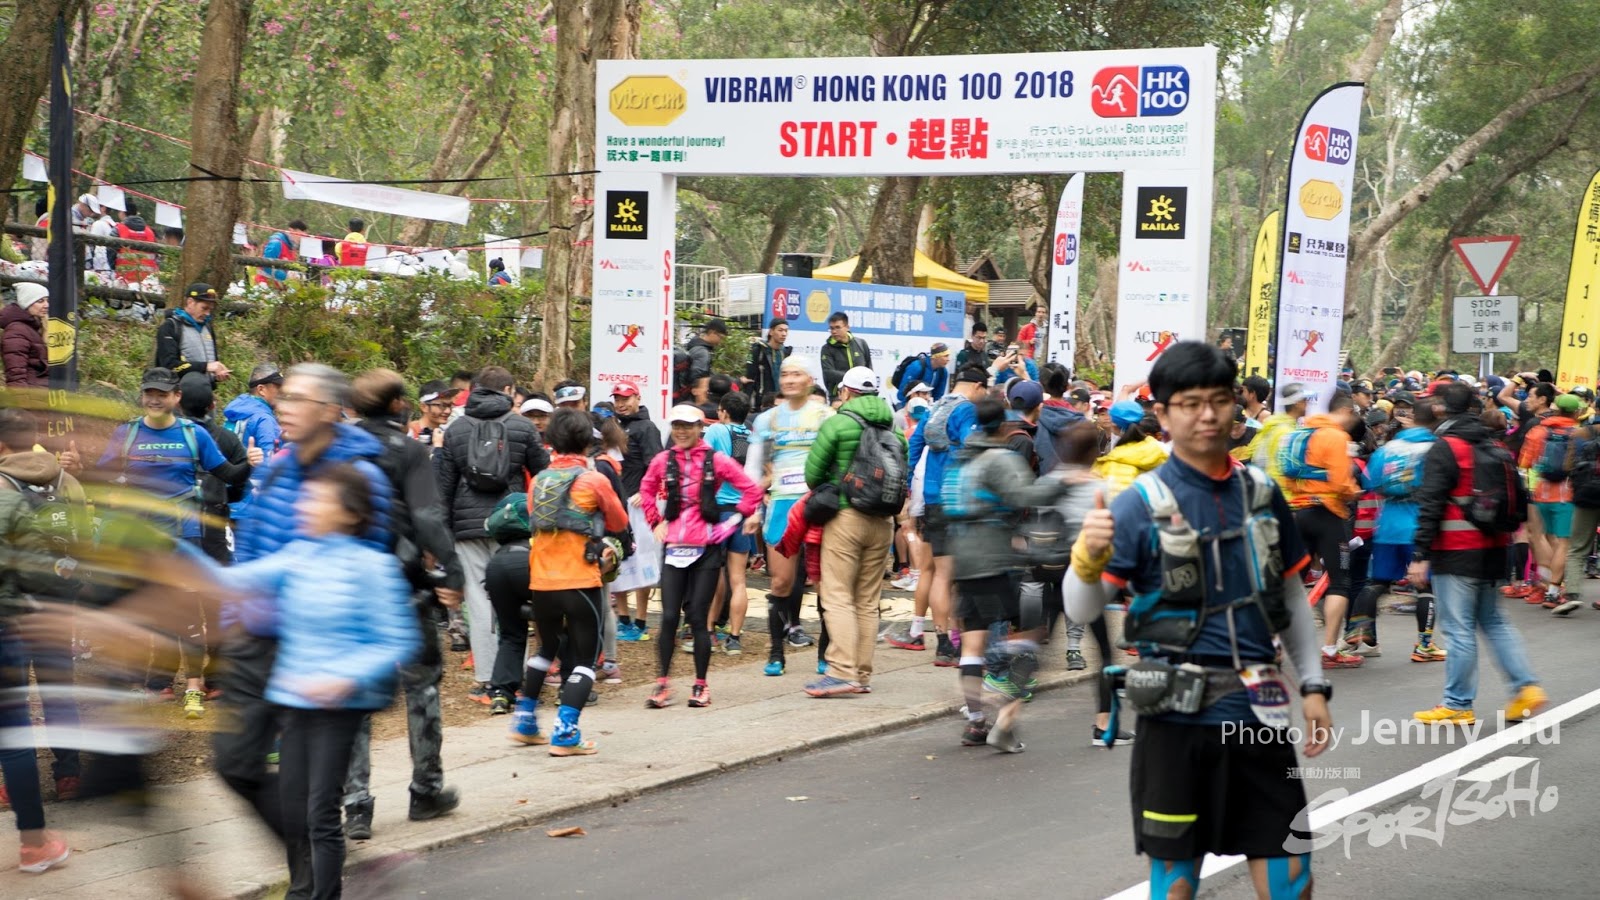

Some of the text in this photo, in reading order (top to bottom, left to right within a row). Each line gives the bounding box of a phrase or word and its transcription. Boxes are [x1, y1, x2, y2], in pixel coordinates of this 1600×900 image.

[814, 75, 876, 102] HONG
[883, 74, 947, 102] KONG
[959, 72, 1002, 100] 100
[1015, 70, 1074, 99] 2018
[1146, 72, 1183, 89] HK
[1142, 91, 1187, 109] 100
[1126, 122, 1188, 134] Bon voyage!
[607, 135, 725, 148] Have a wonderful journey!
[780, 121, 877, 158] START
[907, 118, 989, 160] 起點
[1331, 134, 1350, 148] HK
[1328, 146, 1350, 160] 100
[610, 224, 644, 232] KAILAS
[1141, 223, 1180, 231] KAILAS
[1471, 300, 1500, 308] STOP
[1472, 309, 1500, 317] 100m
[1458, 321, 1514, 332] 一百米前
[661, 250, 671, 419] START
[1473, 337, 1500, 348] 停車
